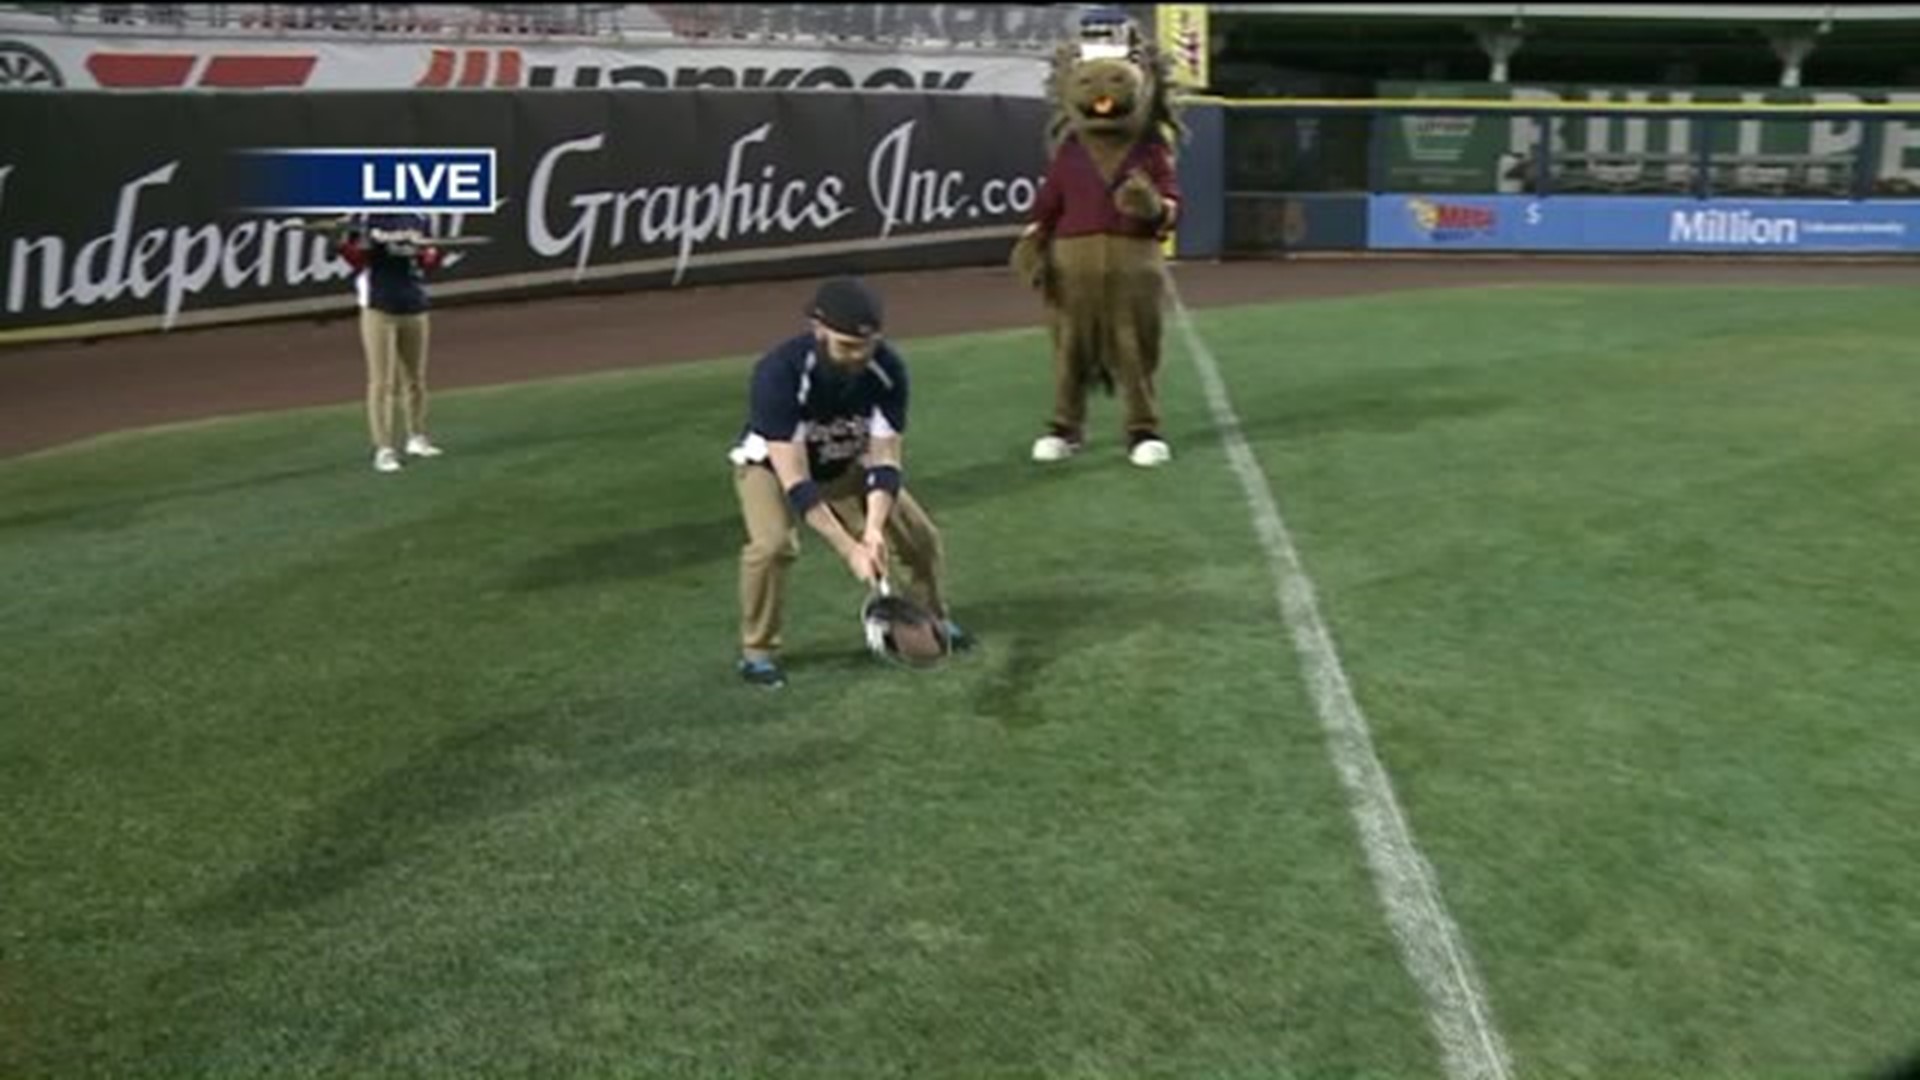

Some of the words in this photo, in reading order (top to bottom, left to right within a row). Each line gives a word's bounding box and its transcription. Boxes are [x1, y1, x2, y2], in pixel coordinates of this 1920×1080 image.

[527, 122, 853, 286] Graphics
[868, 119, 1048, 240] Inc.co
[1669, 209, 1798, 244] Million
